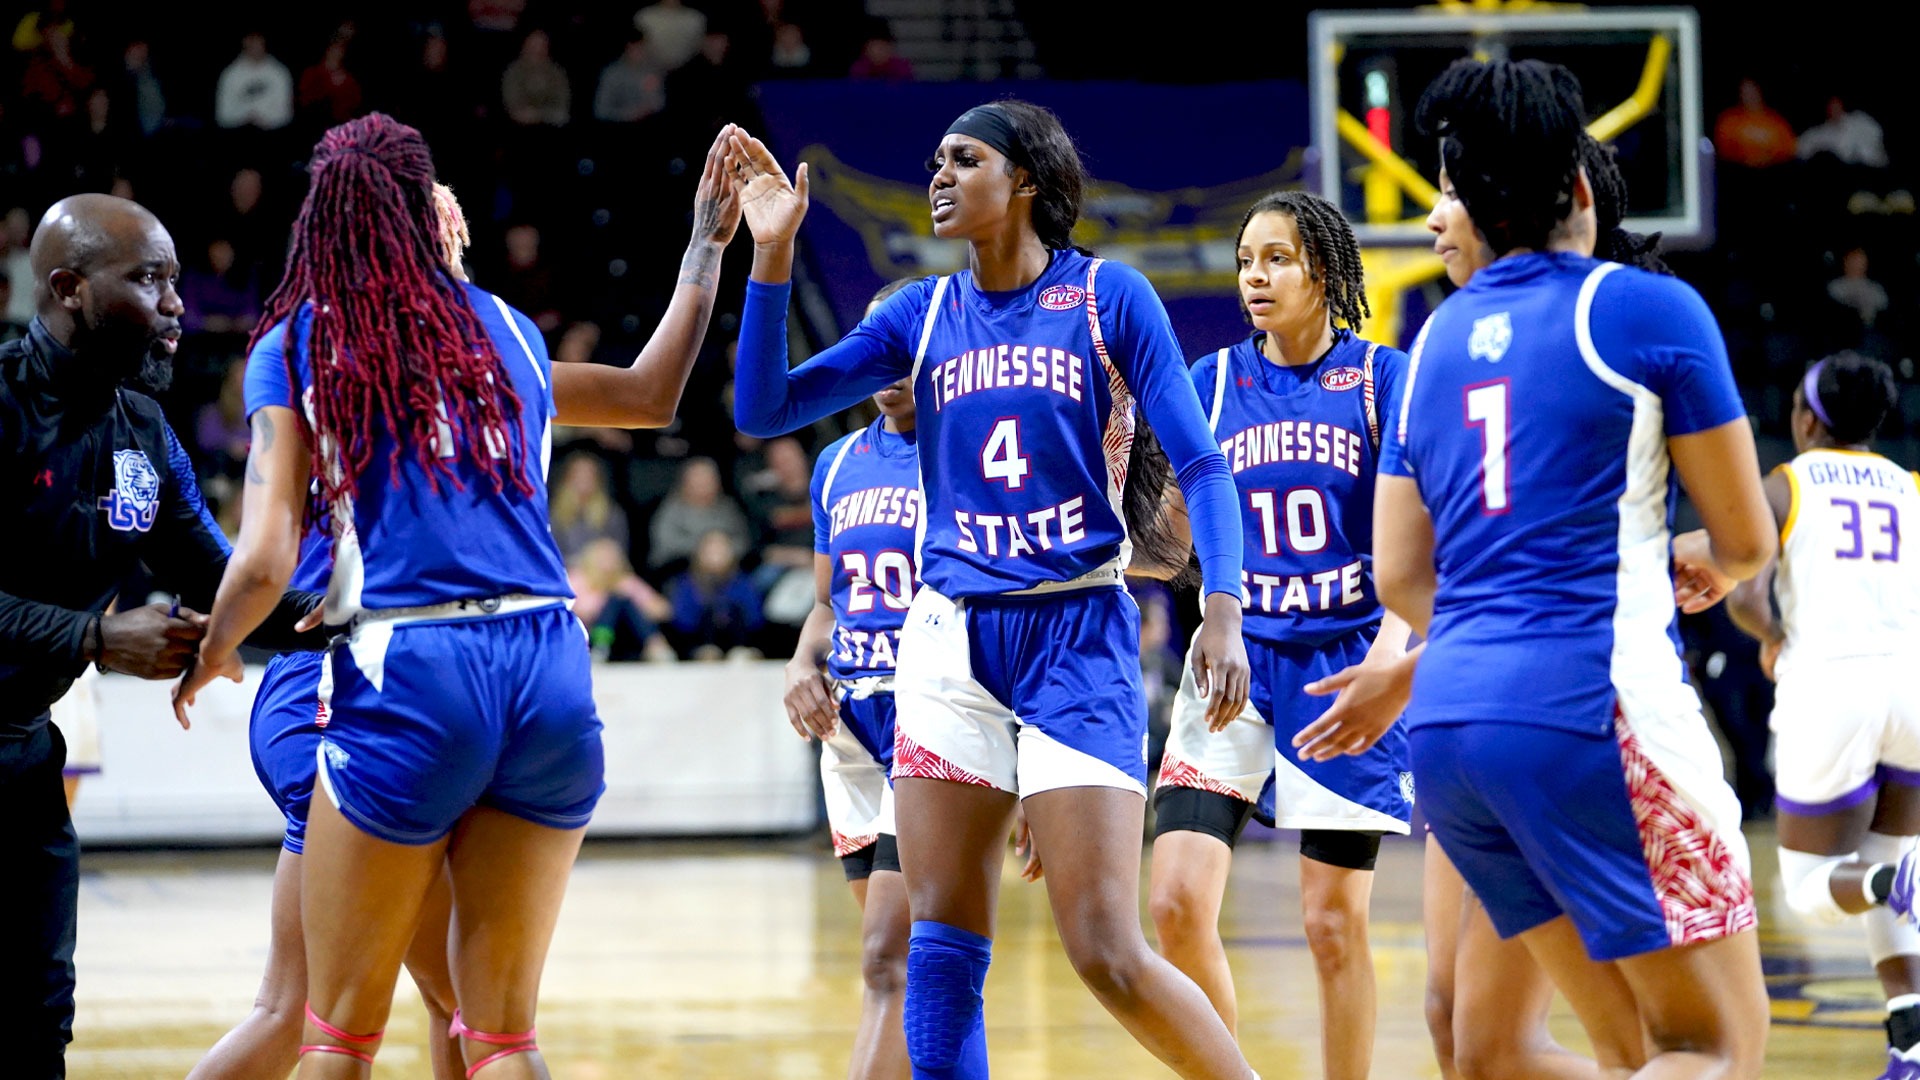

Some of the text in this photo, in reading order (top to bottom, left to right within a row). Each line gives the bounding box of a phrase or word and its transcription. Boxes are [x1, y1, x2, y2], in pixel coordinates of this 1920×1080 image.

[1046, 291, 1078, 304] OVC
[931, 344, 1083, 412] TENNESSEE
[1329, 372, 1358, 385] OVC
[980, 416, 1031, 491] 4
[1220, 421, 1362, 477] TENNESSEE
[1463, 376, 1511, 516] 1
[829, 487, 918, 544] TENNESS
[954, 495, 1086, 557] STATE
[1248, 486, 1330, 557] 10
[1830, 498, 1900, 562] 33
[841, 549, 915, 614] 20
[837, 625, 902, 669] STA
